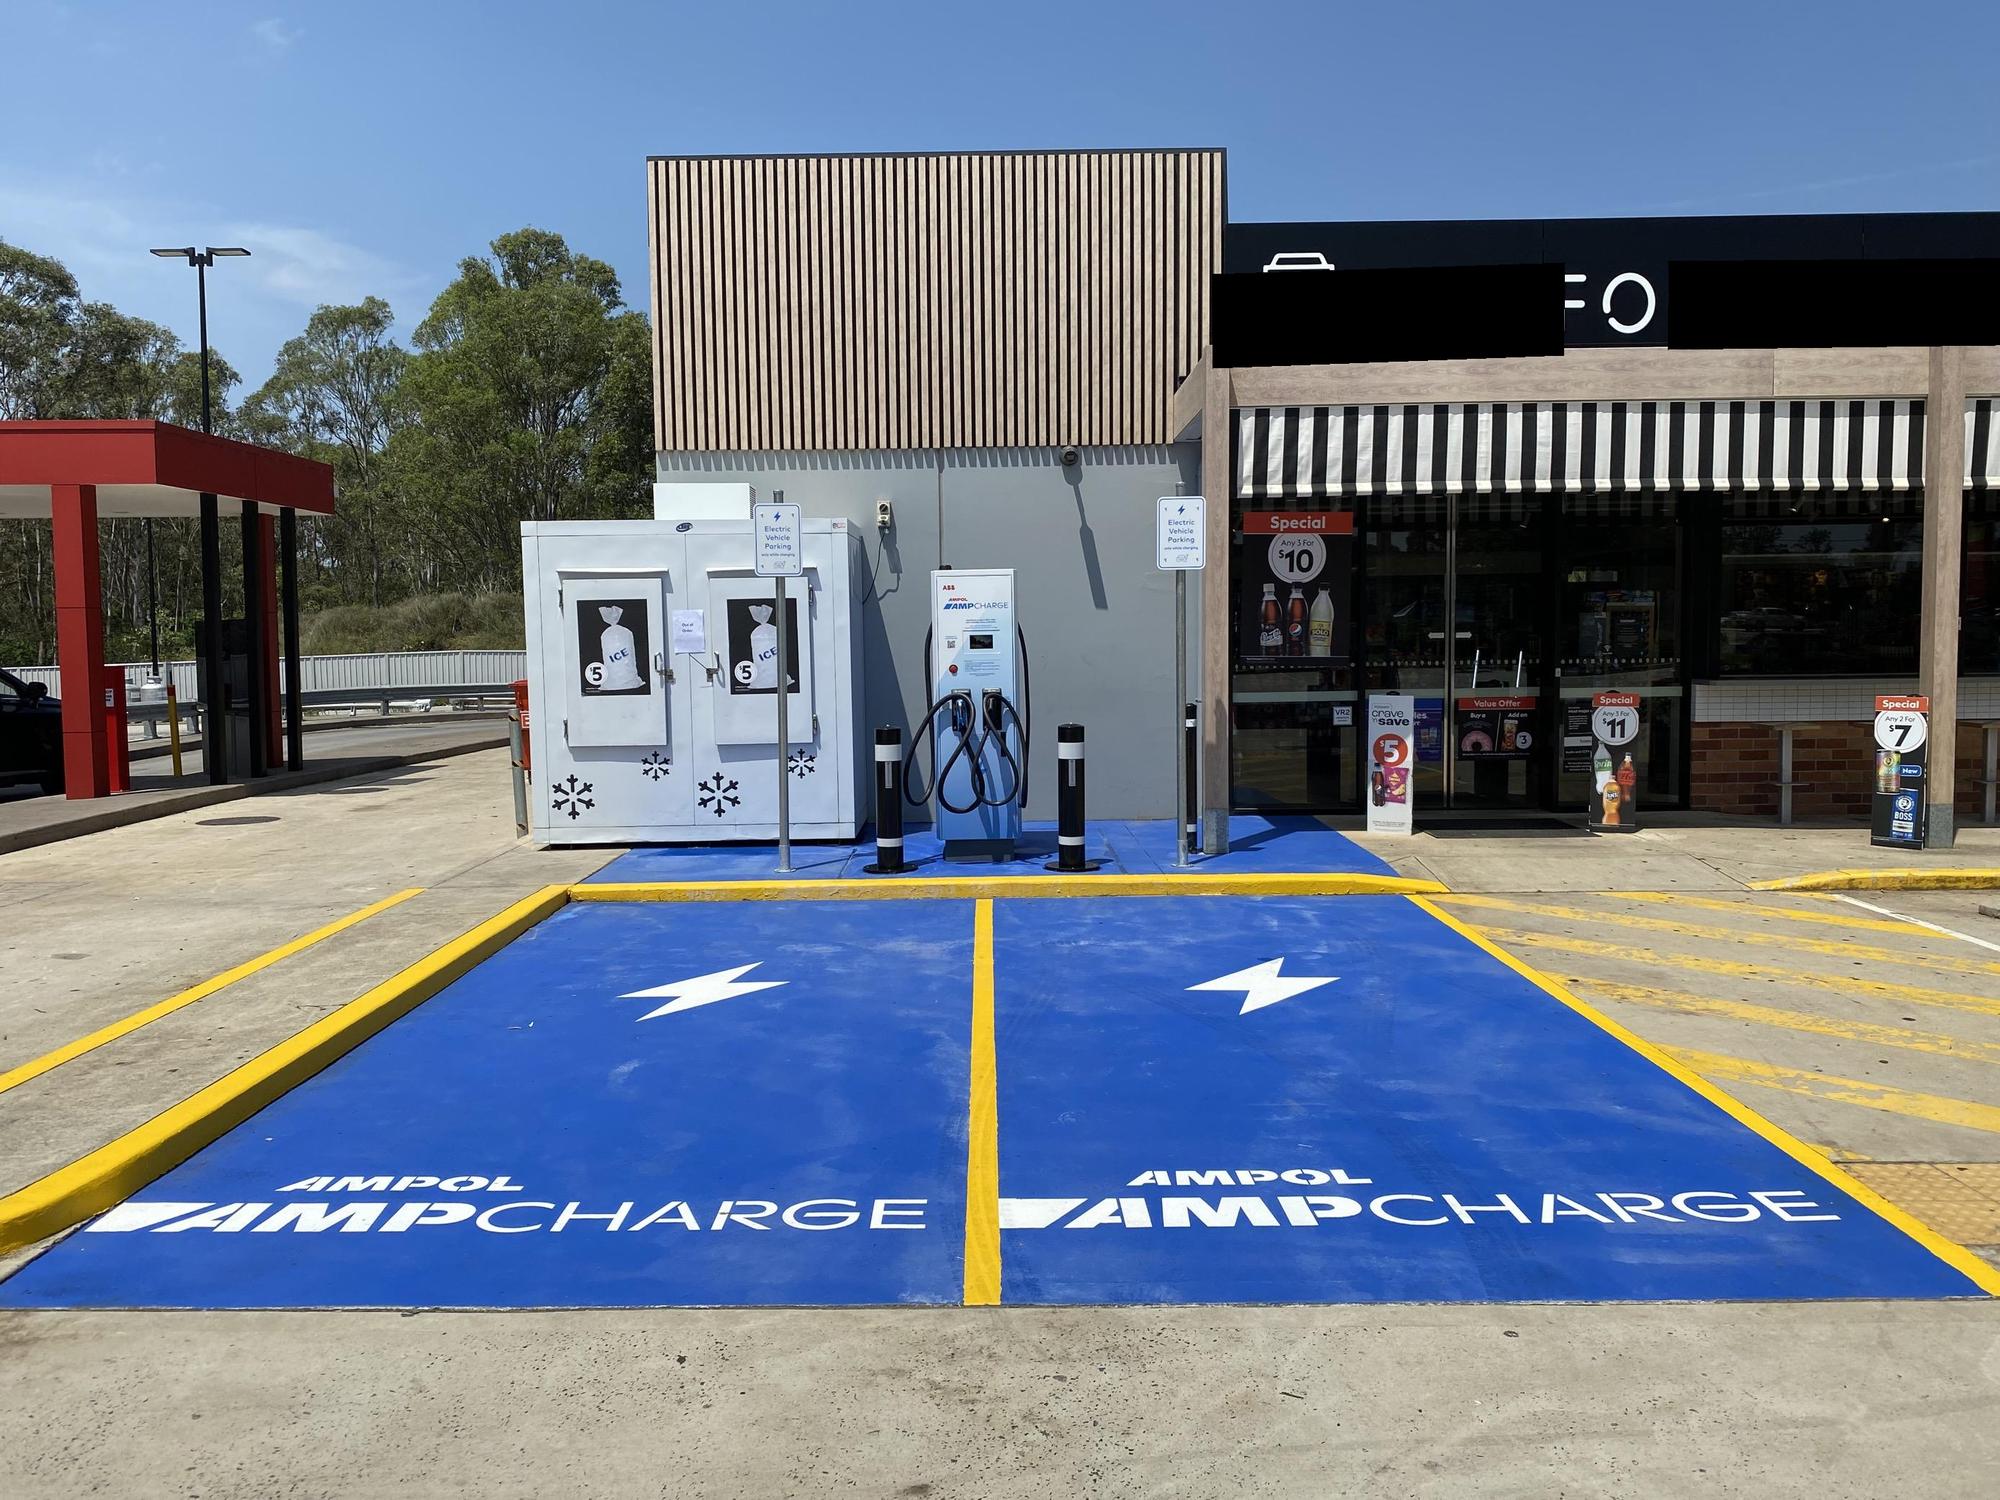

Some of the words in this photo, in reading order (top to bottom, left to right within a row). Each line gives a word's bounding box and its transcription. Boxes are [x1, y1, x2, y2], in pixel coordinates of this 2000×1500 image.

[1270, 516, 1326, 531] Special
[1168, 536, 1195, 544] Parking
[1278, 549, 1314, 573] $10
[951, 602, 1008, 610] AMPCHARGE
[609, 648, 630, 663] ICE
[758, 647, 778, 661] ICE
[590, 666, 602, 682] $5
[739, 665, 752, 680] $5
[1474, 700, 1497, 708] Value
[1600, 696, 1633, 705] Special
[1882, 700, 1919, 709] Special
[1372, 710, 1404, 718] crave
[1378, 718, 1410, 726] save
[1603, 718, 1625, 738] $11
[1889, 725, 1912, 747] $7
[1380, 740, 1400, 763] $5
[1894, 811, 1913, 820] BOSS
[275, 1176, 524, 1191] AMPOL
[1126, 1169, 1373, 1186] AMPOL
[148, 1199, 928, 1232] AMPCHARGE
[1064, 1190, 1841, 1229] AMPCHARGE
